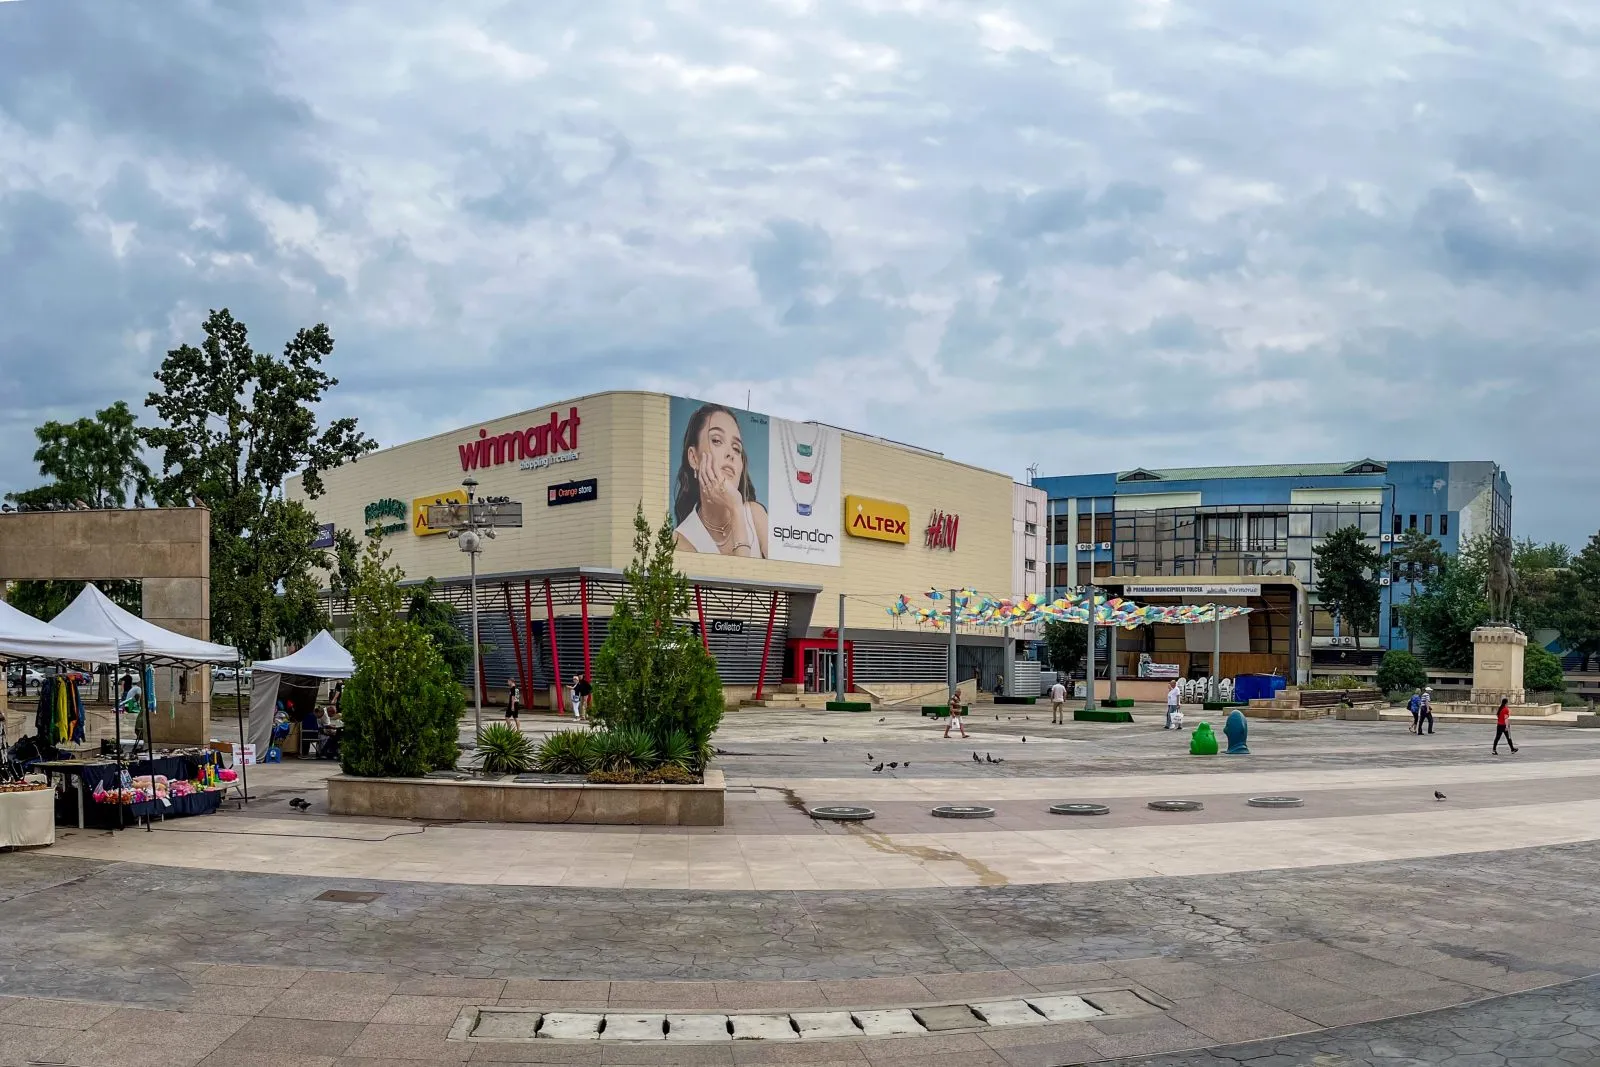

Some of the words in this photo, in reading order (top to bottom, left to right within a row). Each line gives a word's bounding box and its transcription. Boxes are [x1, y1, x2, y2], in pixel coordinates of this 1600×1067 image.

[458, 406, 580, 471] winmarkt
[520, 458, 549, 471] shopping
[558, 488, 577, 497] Orange
[578, 484, 592, 493] store
[773, 525, 834, 544] splend'or
